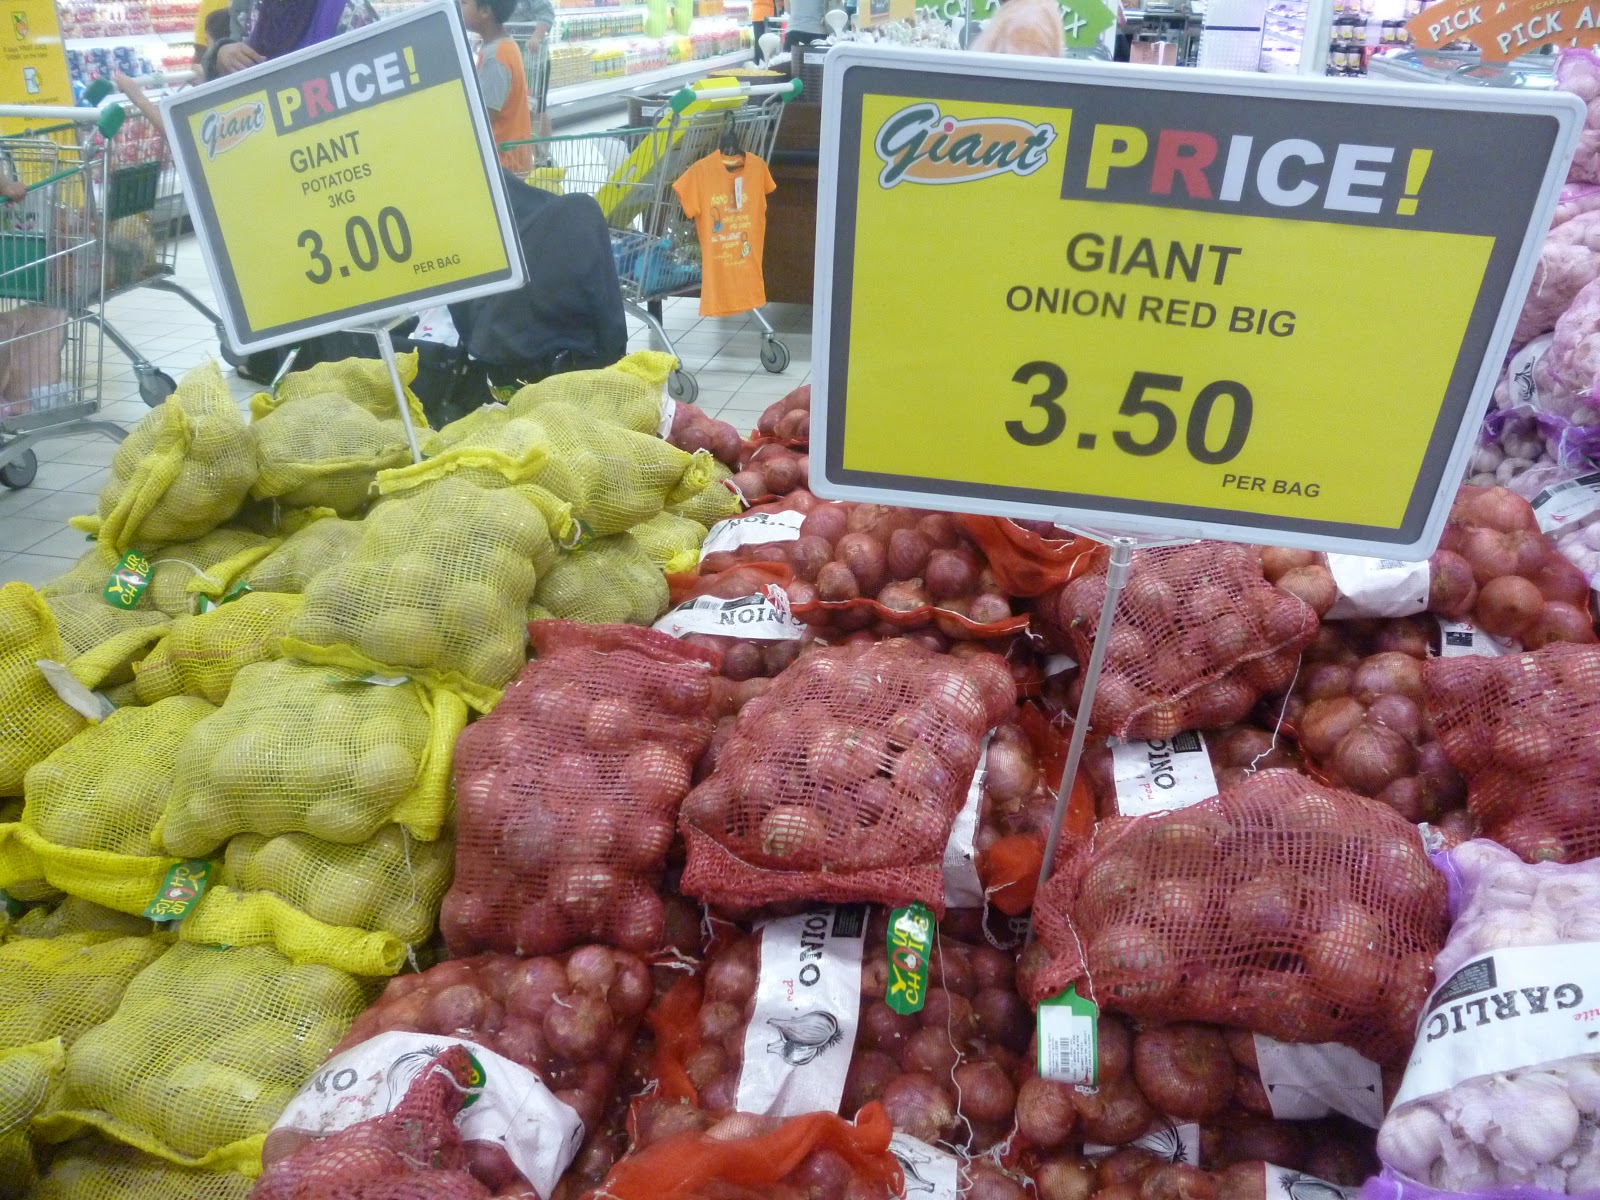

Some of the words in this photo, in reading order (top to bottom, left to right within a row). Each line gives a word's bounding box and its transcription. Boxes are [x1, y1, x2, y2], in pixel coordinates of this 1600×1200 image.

[1428, 6, 1483, 42] PICK
[1497, 11, 1563, 54] PICK
[202, 102, 265, 159] Giant
[276, 46, 421, 129] PRICE!
[290, 131, 361, 173] GIANT
[878, 104, 1054, 187] Giant
[1085, 124, 1434, 217] PRICE!
[301, 163, 372, 196] POTATOES
[328, 190, 356, 209] 3KG
[297, 206, 413, 285] 3.00
[413, 262, 435, 275] PER
[437, 254, 461, 268] BAG
[1066, 232, 1242, 286] GIANT
[1005, 285, 1126, 319] ONION
[1137, 297, 1217, 330] RED
[1228, 305, 1297, 338] BIG
[1004, 360, 1254, 465] 3.50
[1221, 474, 1266, 493] PER
[1272, 480, 1321, 498] BAG
[1426, 983, 1584, 1043] GARLIC
